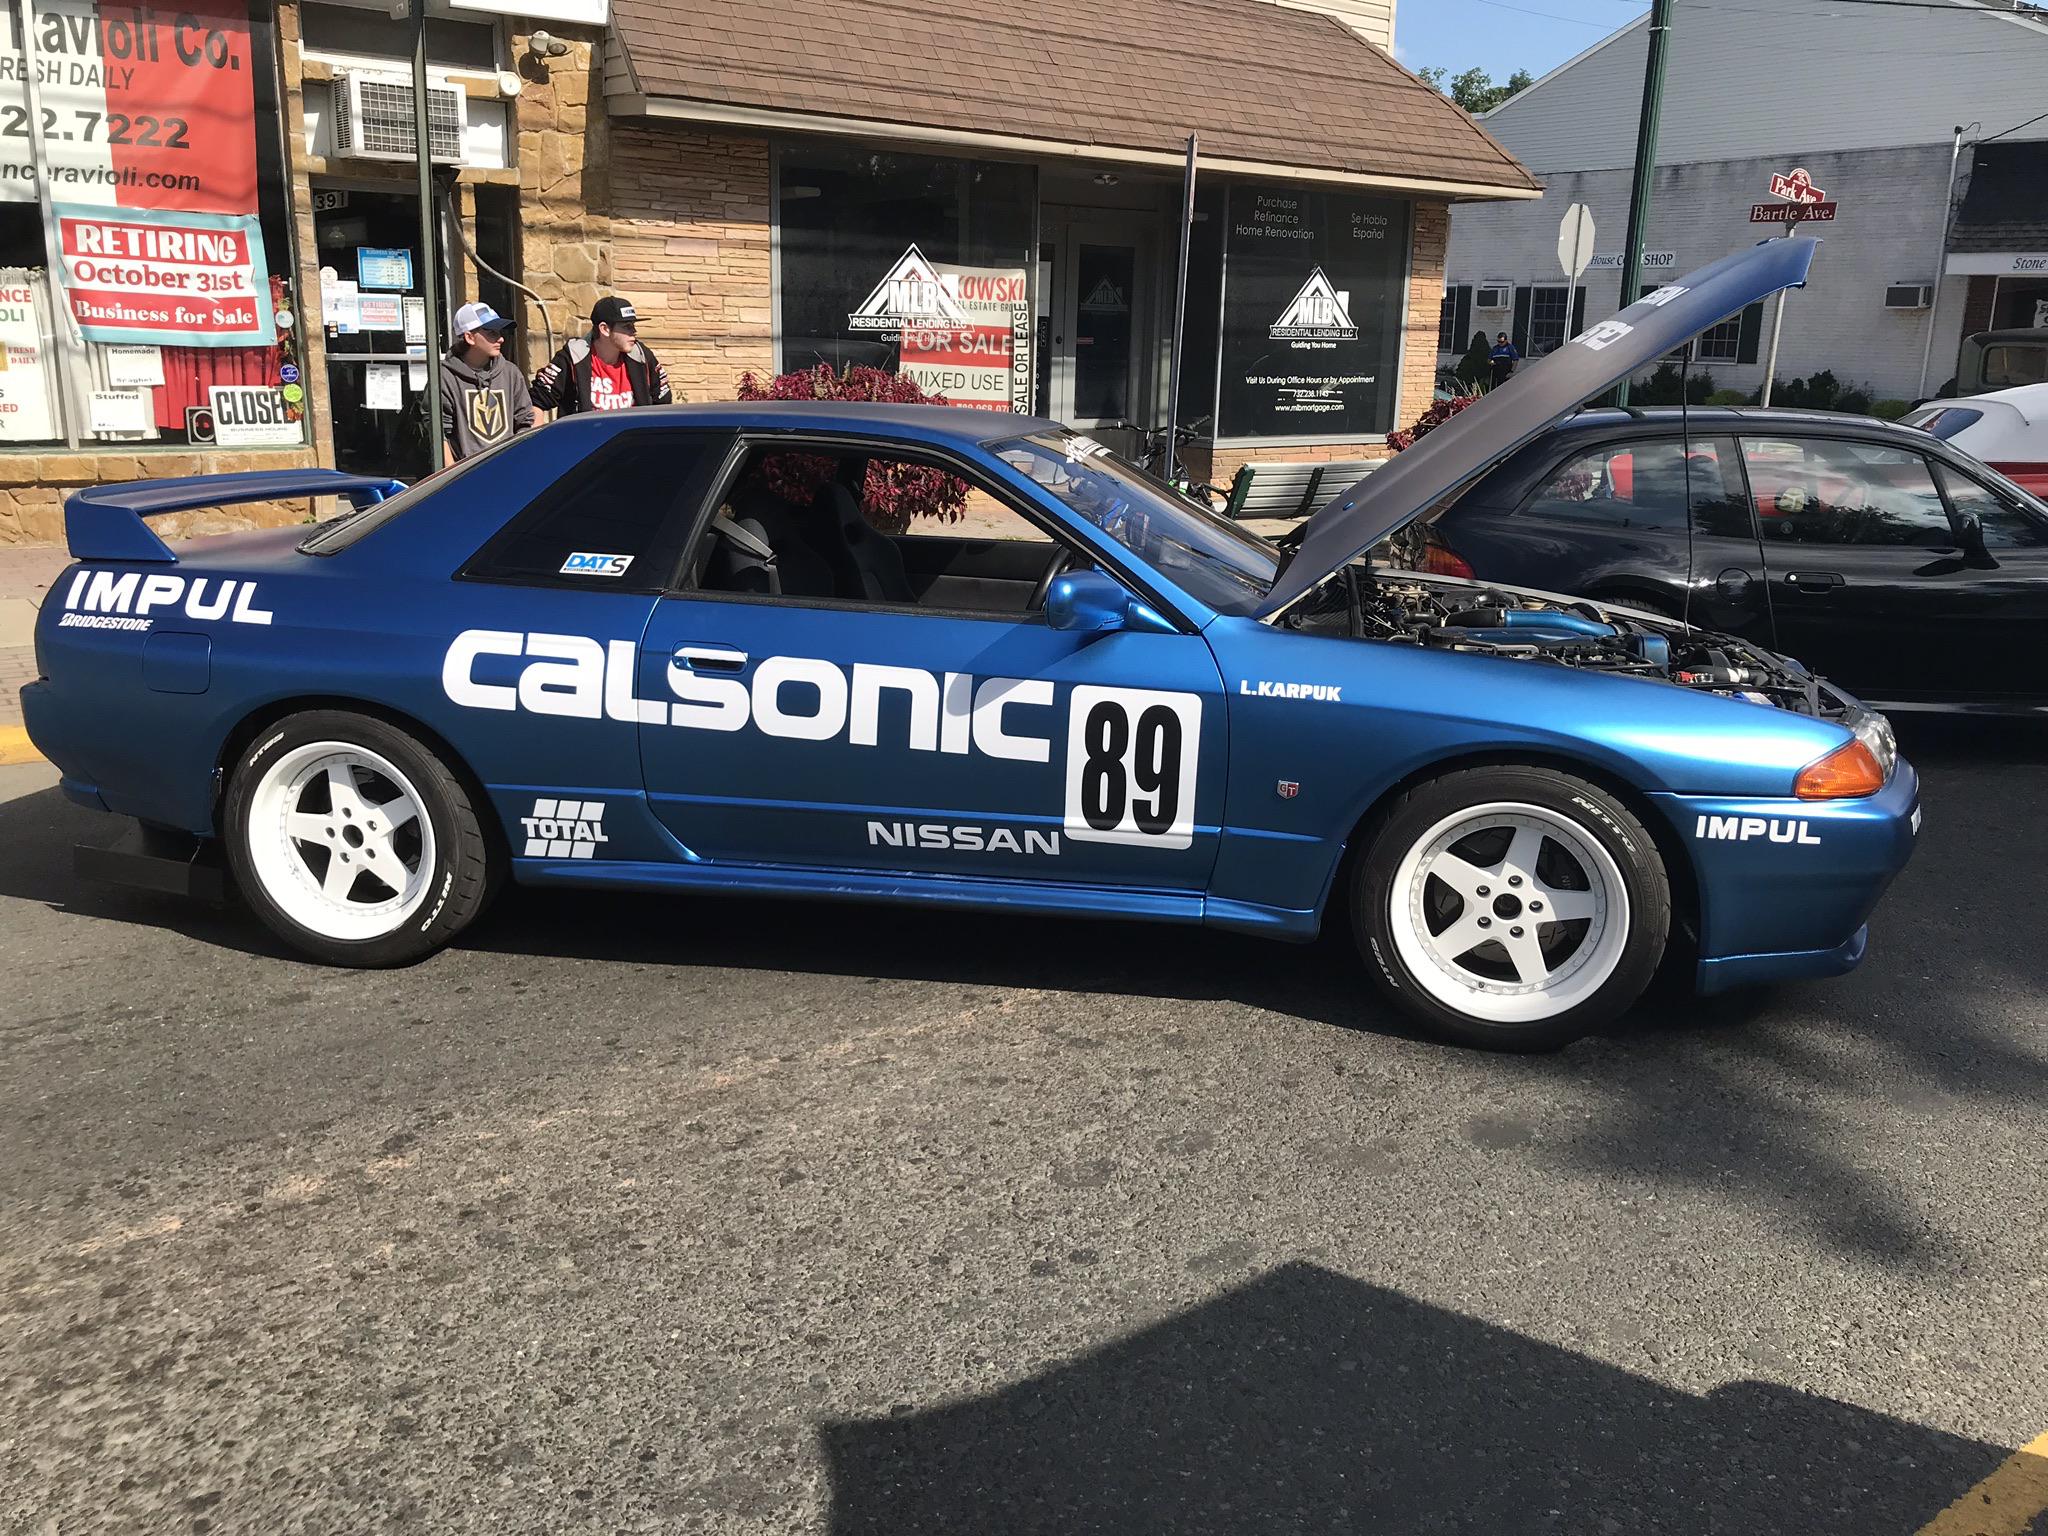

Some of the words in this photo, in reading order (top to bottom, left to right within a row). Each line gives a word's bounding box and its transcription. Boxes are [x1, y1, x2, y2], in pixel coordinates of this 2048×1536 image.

[174, 12, 240, 70] Co.
[69, 61, 135, 90] DAILY
[315, 191, 346, 210] 391
[1774, 177, 1797, 200] Park
[1799, 188, 1817, 203] Ave
[1257, 195, 1298, 210] Purchase
[1751, 205, 1798, 221] Bartle
[1802, 204, 1833, 221] Ave.
[1254, 211, 1299, 224] Refinance
[1351, 213, 1361, 224] Se
[1363, 214, 1388, 226] Habla
[1236, 224, 1263, 236] Home
[1265, 226, 1315, 240] Renovation
[1353, 227, 1385, 239] Español
[75, 224, 237, 264] RETIRING
[1591, 255, 1615, 265] House
[1644, 254, 1673, 265] SHOP
[2013, 257, 2047, 269] Stone
[74, 260, 190, 289] October
[197, 271, 244, 292] 31st
[888, 280, 938, 314] MLB
[970, 301, 997, 312] ESTATE
[75, 300, 169, 323] Business
[175, 305, 207, 325] for
[212, 306, 253, 326] Sale
[1299, 297, 1333, 324] MLB
[852, 317, 911, 329] RESIDENTIAL
[912, 318, 949, 329] LENDING
[951, 319, 967, 330] LLC
[1014, 303, 1028, 349] LEASE
[1271, 328, 1313, 337] RESIDENTIAL
[1313, 329, 1340, 338] LENDING
[1341, 329, 1354, 338] LLC
[8, 346, 35, 354] FRESH
[903, 330, 952, 353] FOR
[959, 332, 1013, 356] SALE
[1291, 341, 1311, 349] Guiding
[1311, 341, 1320, 349] You
[1321, 341, 1337, 349] Home
[11, 356, 37, 364] DAILY
[1014, 353, 1028, 373] OR
[908, 369, 966, 390] MIXED
[971, 374, 1004, 391] USE
[1245, 376, 1258, 384] Visit
[1266, 377, 1286, 386] During
[1330, 376, 1338, 385] by
[1338, 376, 1375, 385] Appointment
[1014, 374, 1028, 414] SALE
[567, 554, 629, 574] DATS
[64, 570, 274, 625] IMPUL
[58, 612, 153, 631] BRIDGESTONE
[1240, 680, 1342, 701] L.KARPUK
[1081, 701, 1182, 835] 89
[521, 817, 608, 842] TOTAL
[1571, 796, 1636, 852] NITTO
[1695, 815, 1821, 845] IMPUL
[867, 821, 1060, 855] NISSAN
[421, 871, 453, 932] NITTO
